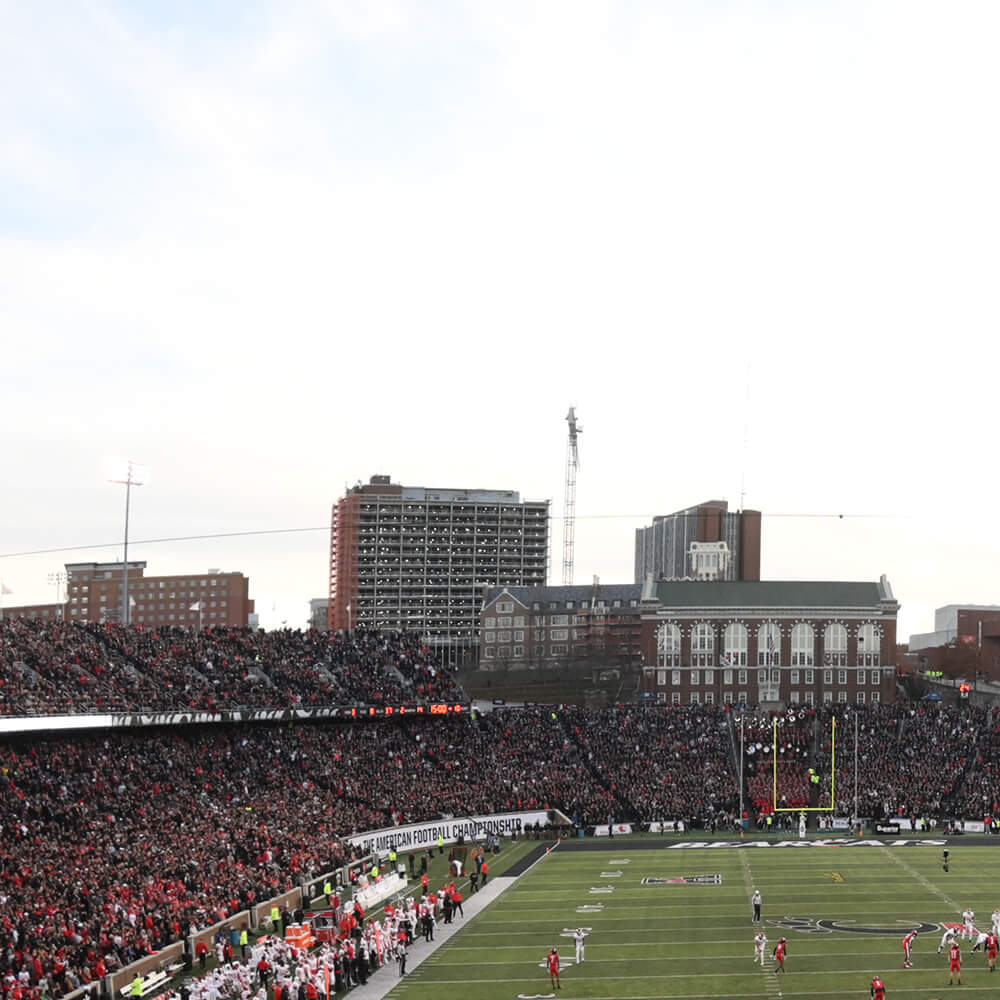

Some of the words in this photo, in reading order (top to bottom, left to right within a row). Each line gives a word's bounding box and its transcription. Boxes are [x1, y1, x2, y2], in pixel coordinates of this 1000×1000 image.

[376, 833, 412, 851] AMERICAN
[413, 828, 451, 844] FOOTBALL
[452, 818, 522, 838] CHAMPIONSHIP
